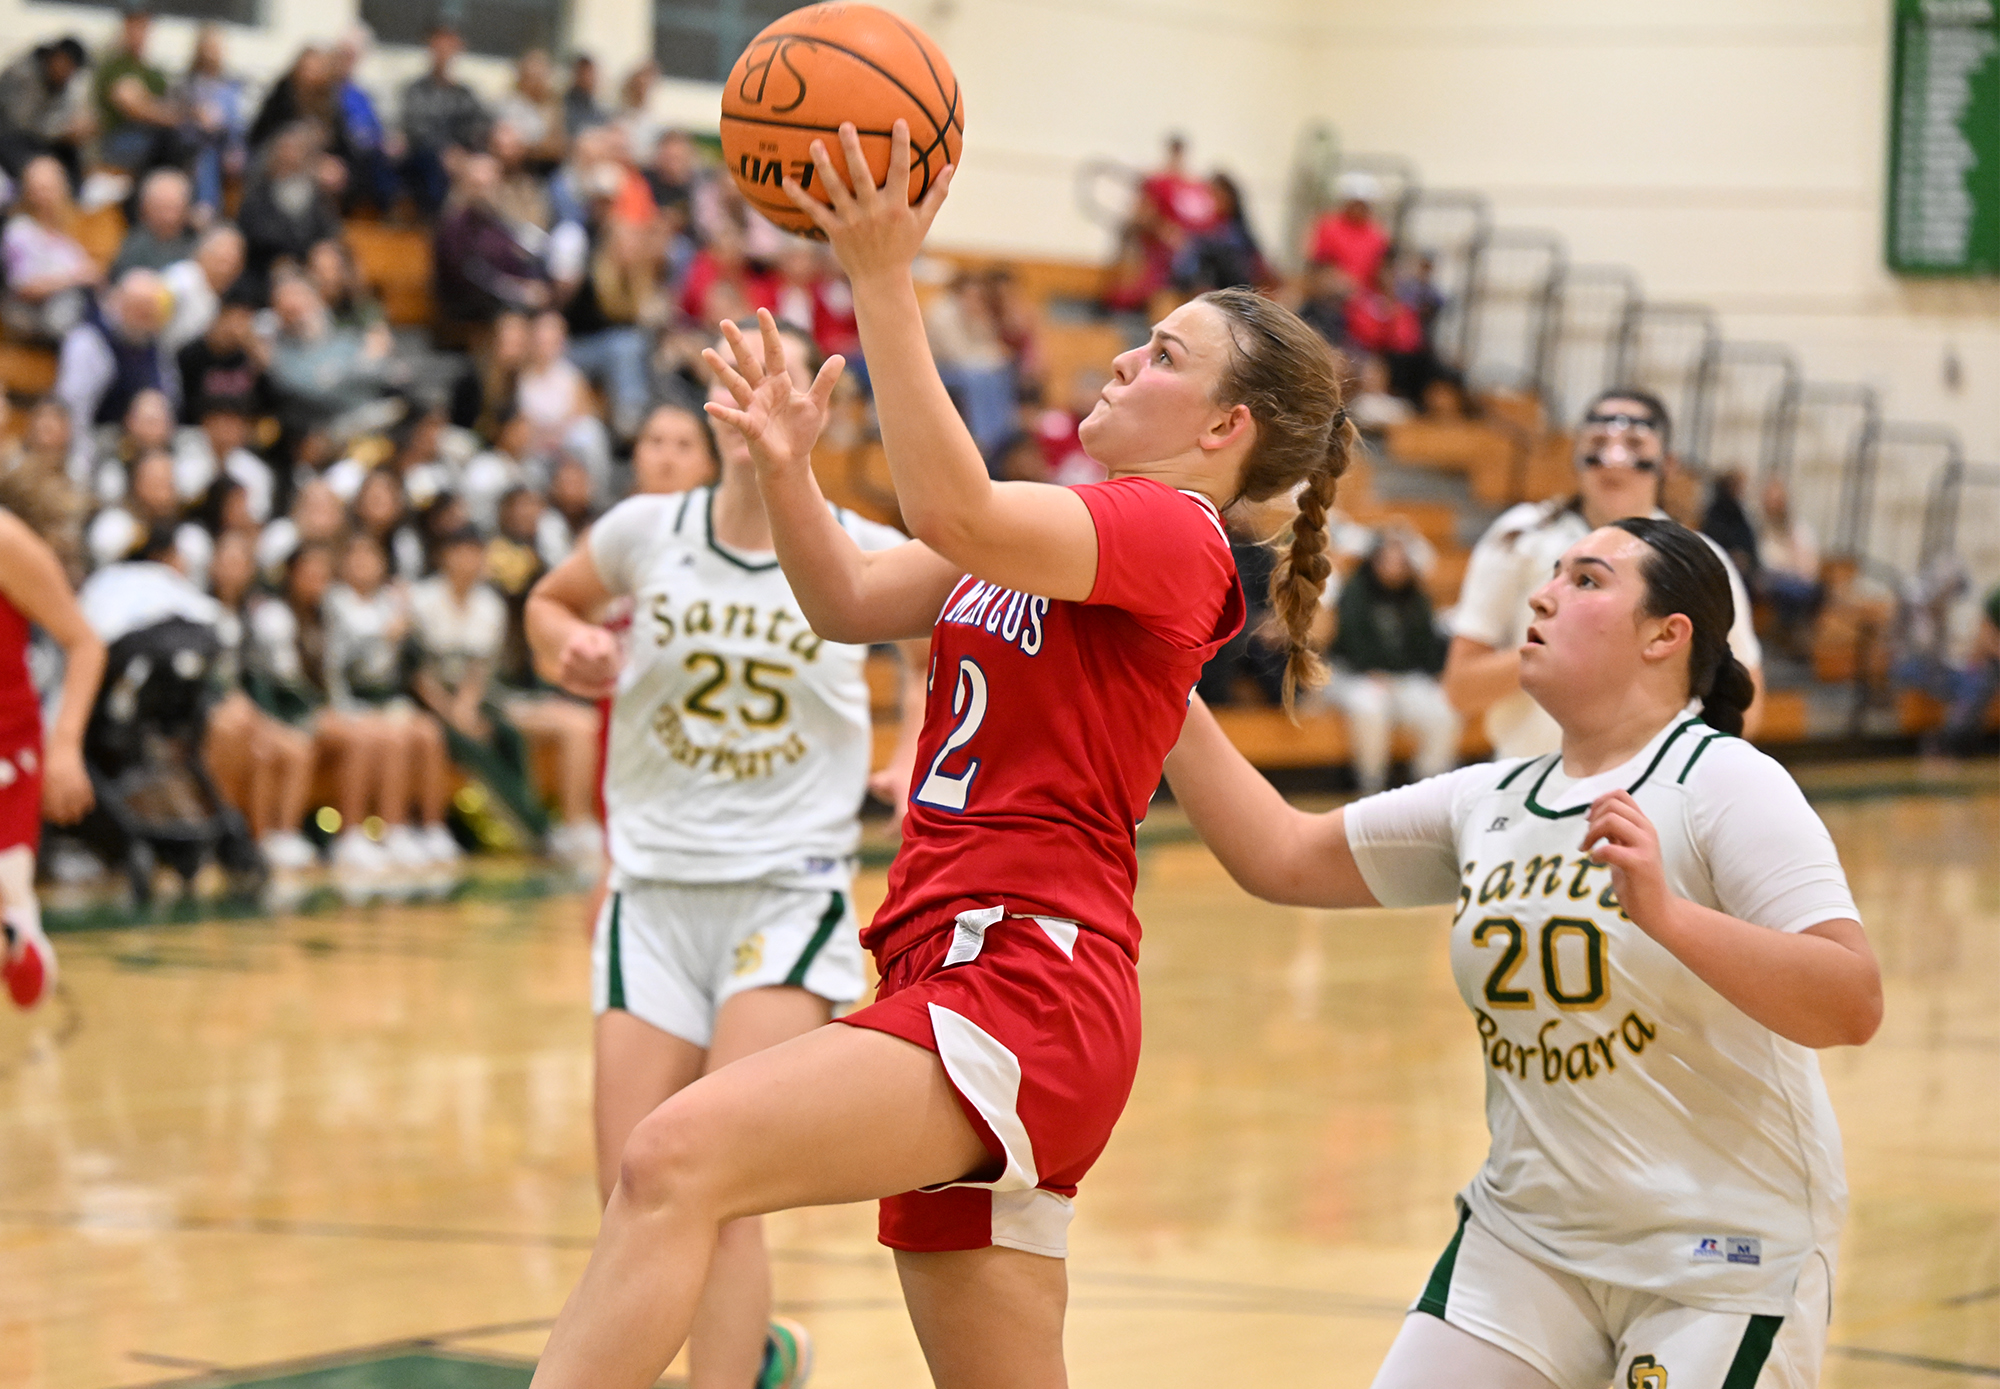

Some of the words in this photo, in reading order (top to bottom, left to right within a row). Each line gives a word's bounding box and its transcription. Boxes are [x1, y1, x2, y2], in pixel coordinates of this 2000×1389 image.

[653, 593, 826, 664] Santa
[682, 650, 796, 730] 25
[911, 654, 988, 814] 2
[1471, 915, 1612, 1013] 20
